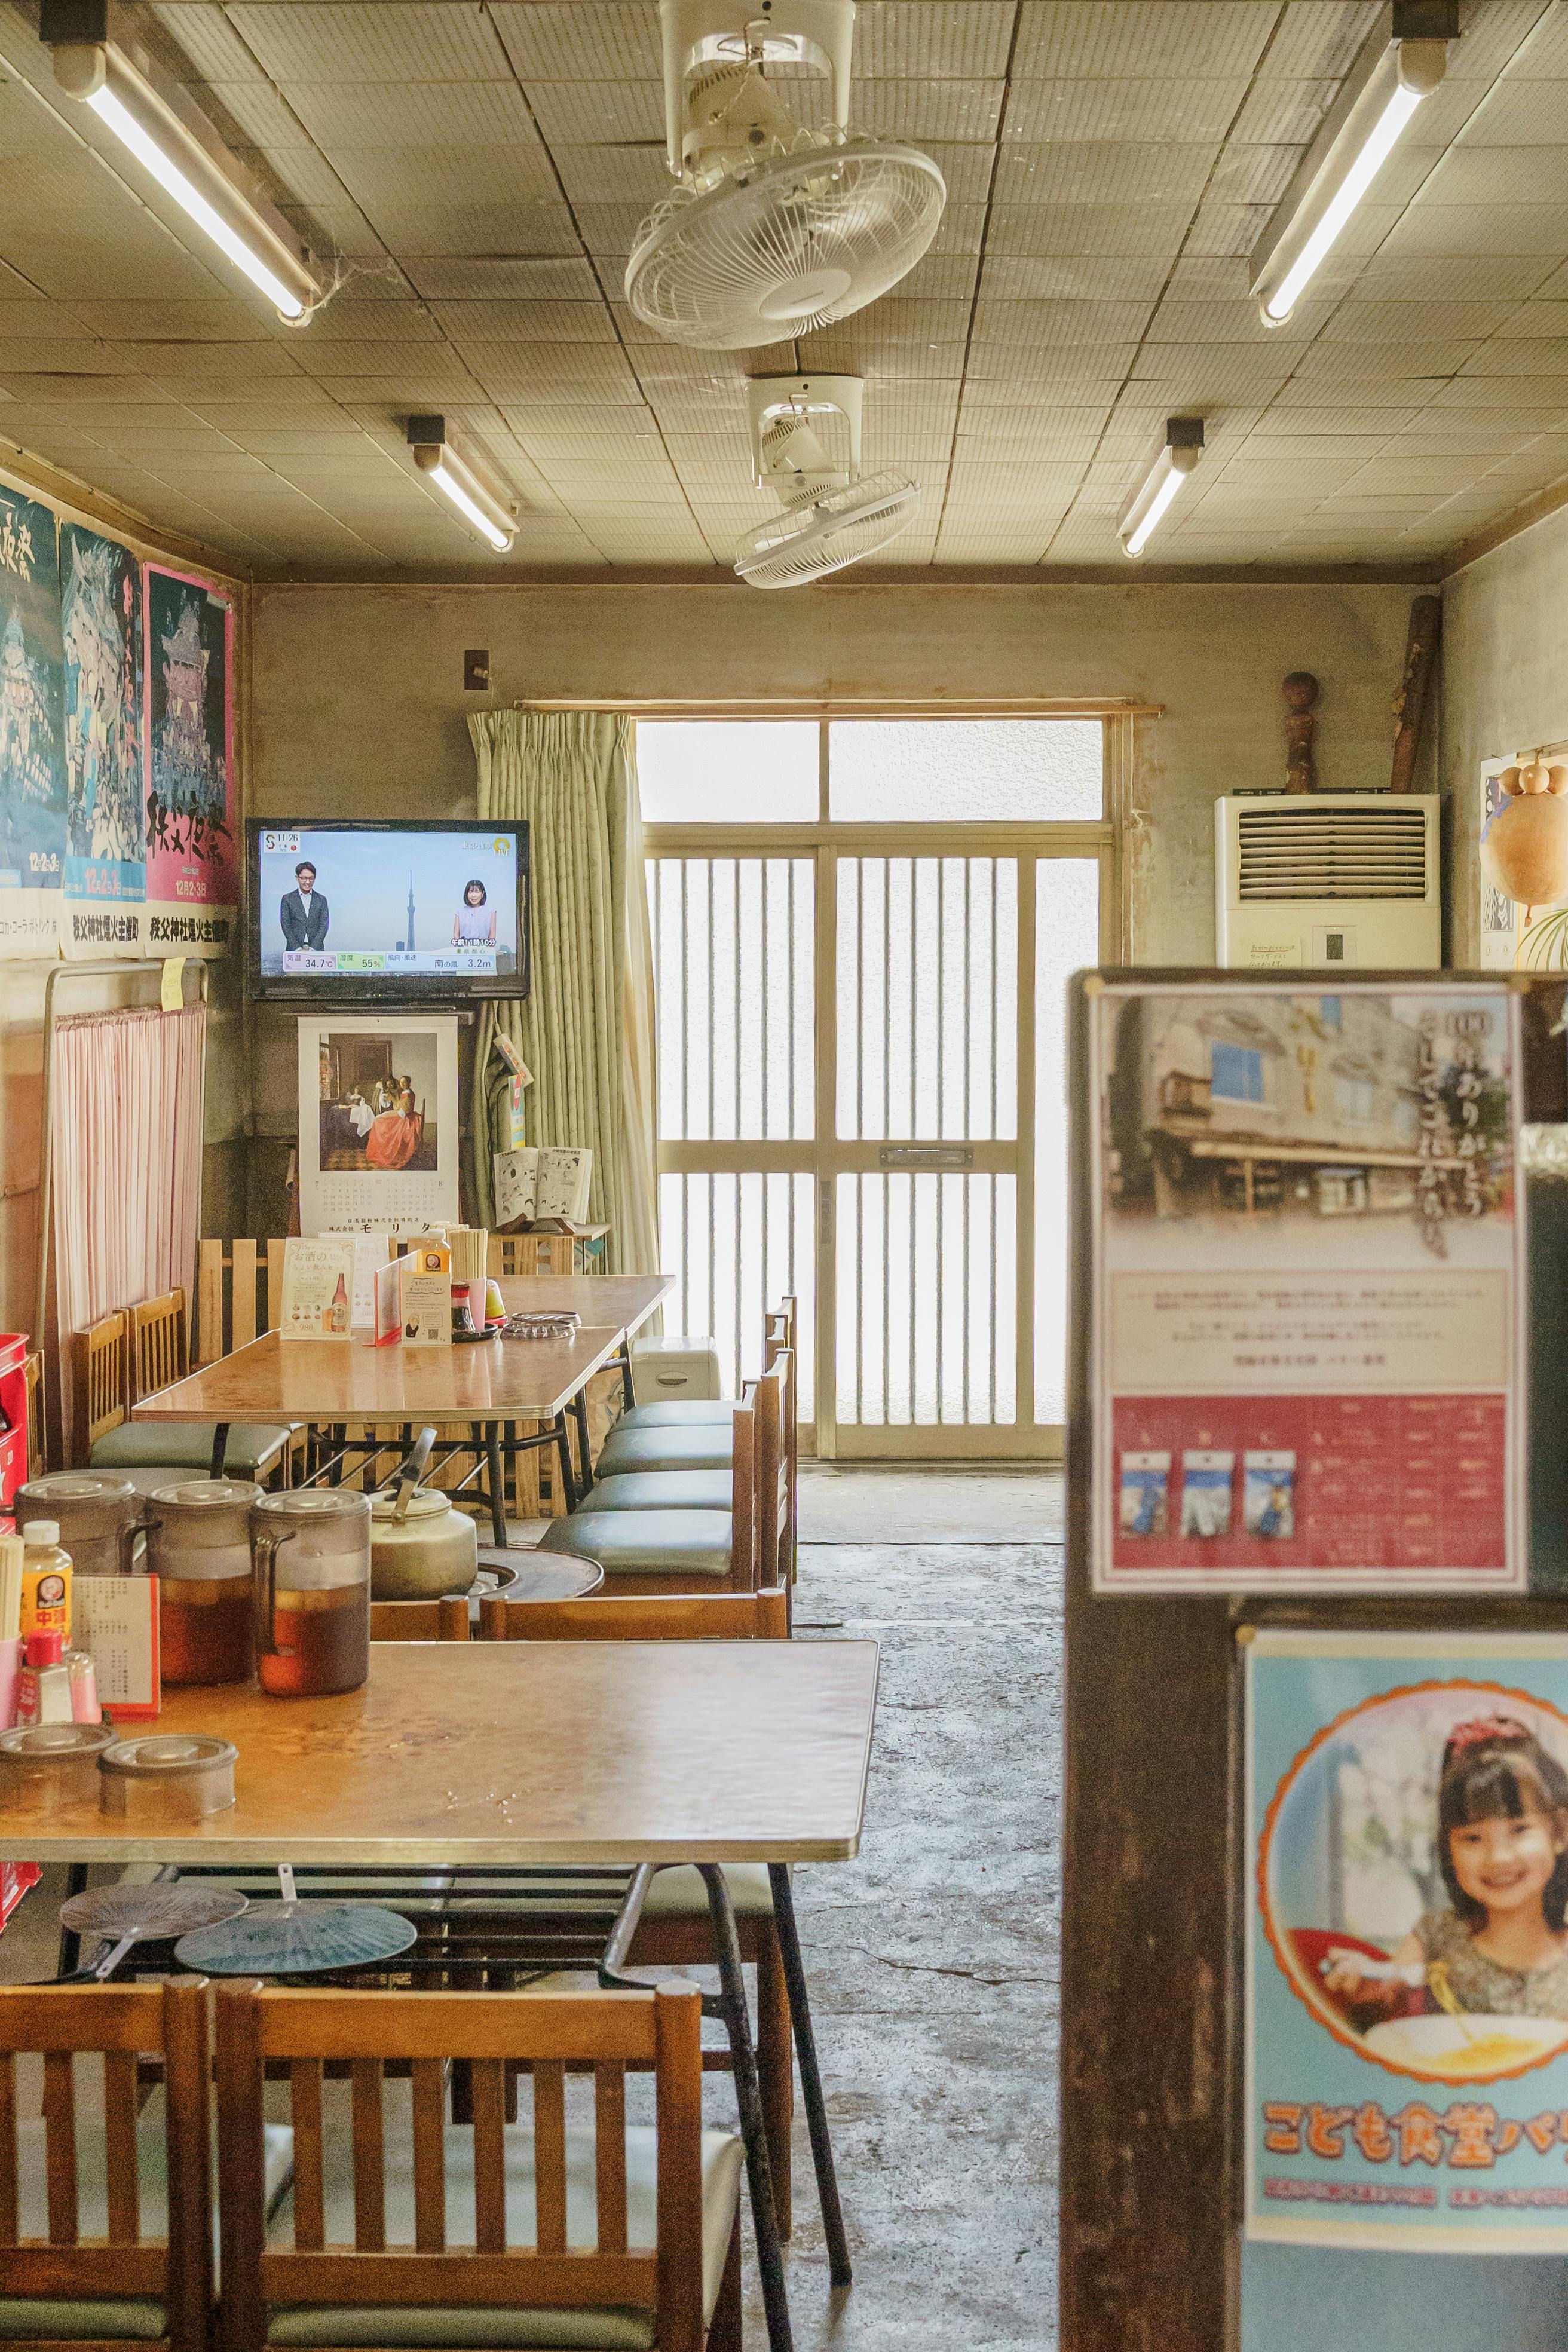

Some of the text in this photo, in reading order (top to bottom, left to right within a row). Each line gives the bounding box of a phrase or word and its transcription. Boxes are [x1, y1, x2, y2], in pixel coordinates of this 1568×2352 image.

[278, 834, 298, 842] 11:26
[451, 938, 496, 947] 午前11時10分
[362, 959, 381, 968] 55%
[434, 959, 458, 968] 南の風
[468, 959, 491, 968] 3.2m
